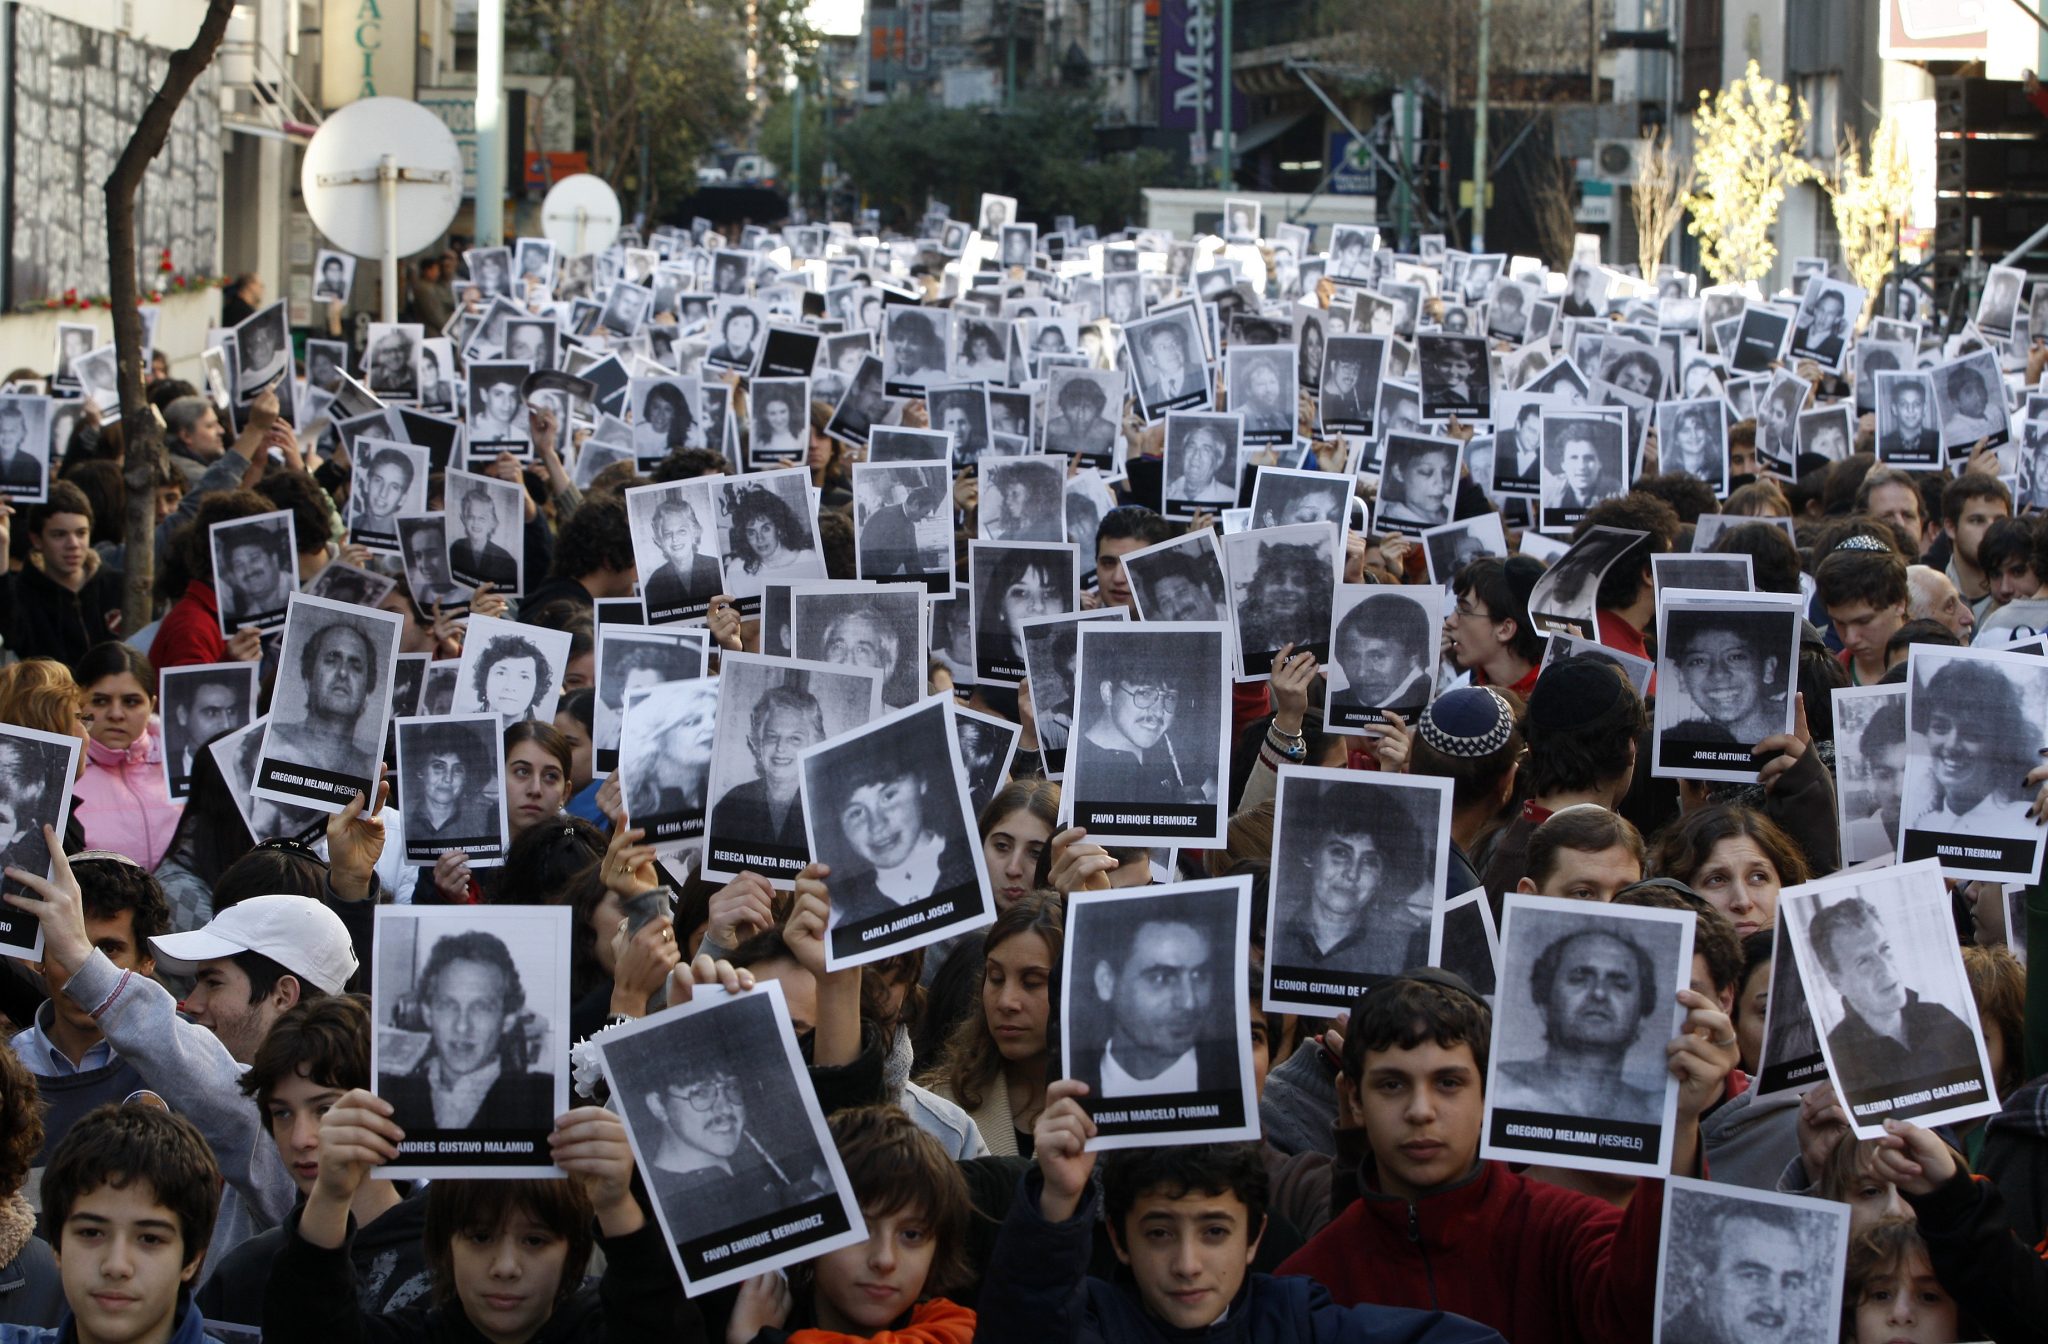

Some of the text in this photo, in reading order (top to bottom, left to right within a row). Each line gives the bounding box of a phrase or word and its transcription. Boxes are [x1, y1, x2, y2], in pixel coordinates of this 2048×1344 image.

[651, 609, 672, 619] REBECA
[672, 605, 693, 615] VIOLETA
[991, 666, 1010, 674] ANALIA
[1345, 713, 1372, 721] ADHEMAR
[1692, 751, 1751, 762] JORGE ANTUNEZ
[270, 771, 304, 785] GREGORIO
[304, 778, 334, 792] MELMAN
[656, 818, 704, 835] ELENA SOFIA
[1091, 813, 1198, 826] FAVIO ENRIQUE BERMUDEZ
[714, 850, 808, 870] REBECA VIOLETA BEHAR
[1937, 844, 2002, 860] MARTA TREIBMAN
[861, 902, 954, 941] CARLA ANDREA JOSCH
[1273, 978, 1308, 992] LEONOR
[1309, 982, 1346, 996] GUTMAN
[1347, 985, 1360, 997] DE
[1787, 1065, 1812, 1079] ILEANA
[1853, 1079, 1981, 1116] GUILLERMO BENIGNO GALARRAGA
[1093, 1104, 1220, 1124] FABIAN MARCELO FURMAN
[1505, 1124, 1643, 1151] GREGORIO MELMAN (HESHELE)
[397, 1141, 535, 1153] ANDRES GUSTAVO MALAMUD
[702, 1213, 824, 1263] FAVIO ENRIQUE BERMUDEZ
